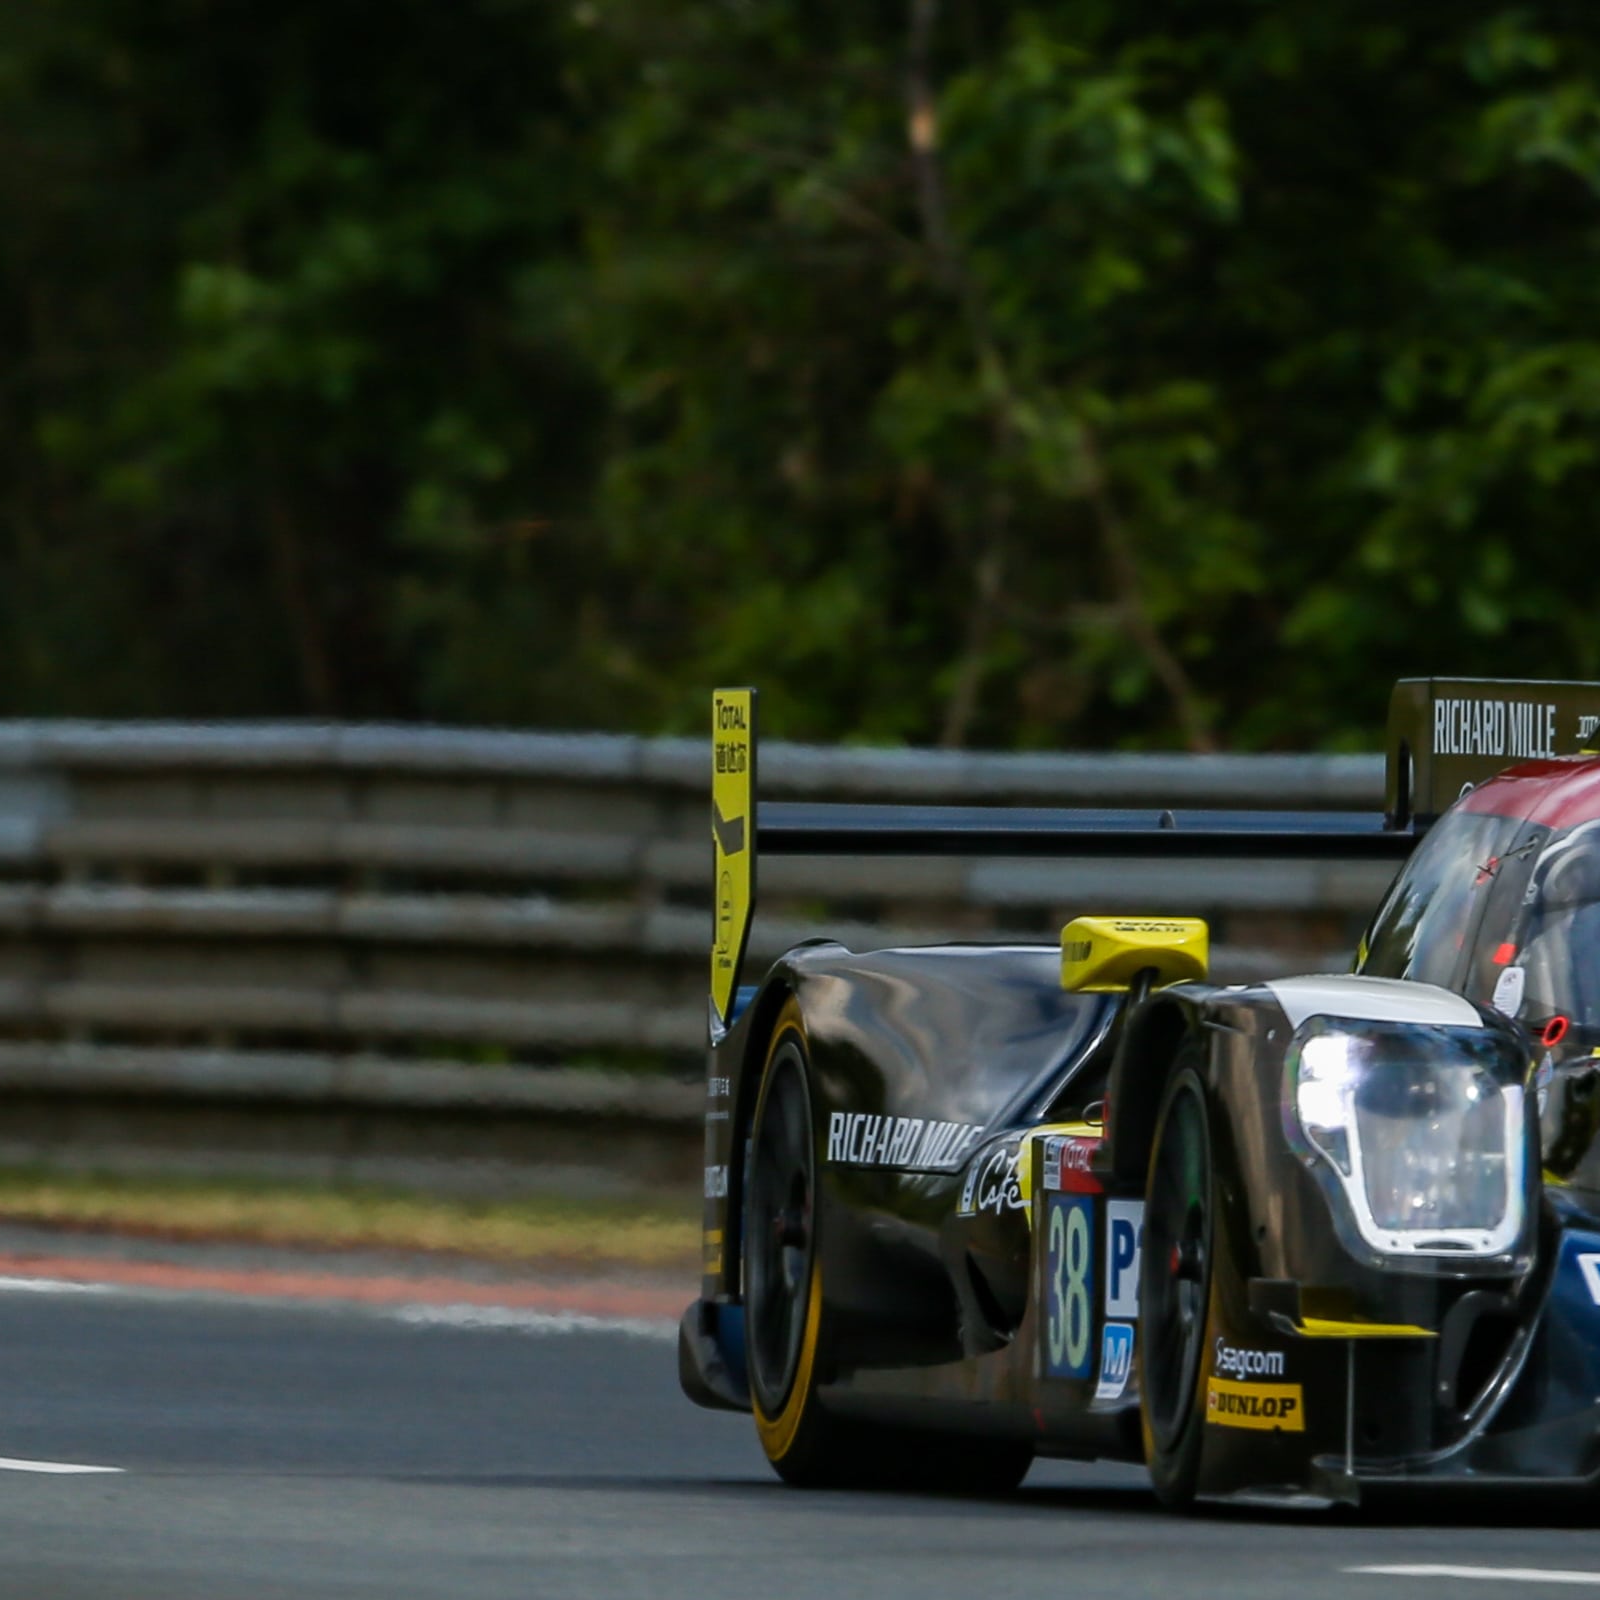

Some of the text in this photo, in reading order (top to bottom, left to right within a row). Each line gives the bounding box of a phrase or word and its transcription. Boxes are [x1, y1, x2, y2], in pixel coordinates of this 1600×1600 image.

[715, 698, 747, 731] TOTAL
[1433, 699, 1557, 760] RICHARD MILLE
[827, 1111, 924, 1165] RICHARD
[1050, 1204, 1090, 1370] 38
[1217, 1391, 1297, 1418] DUNLOP
